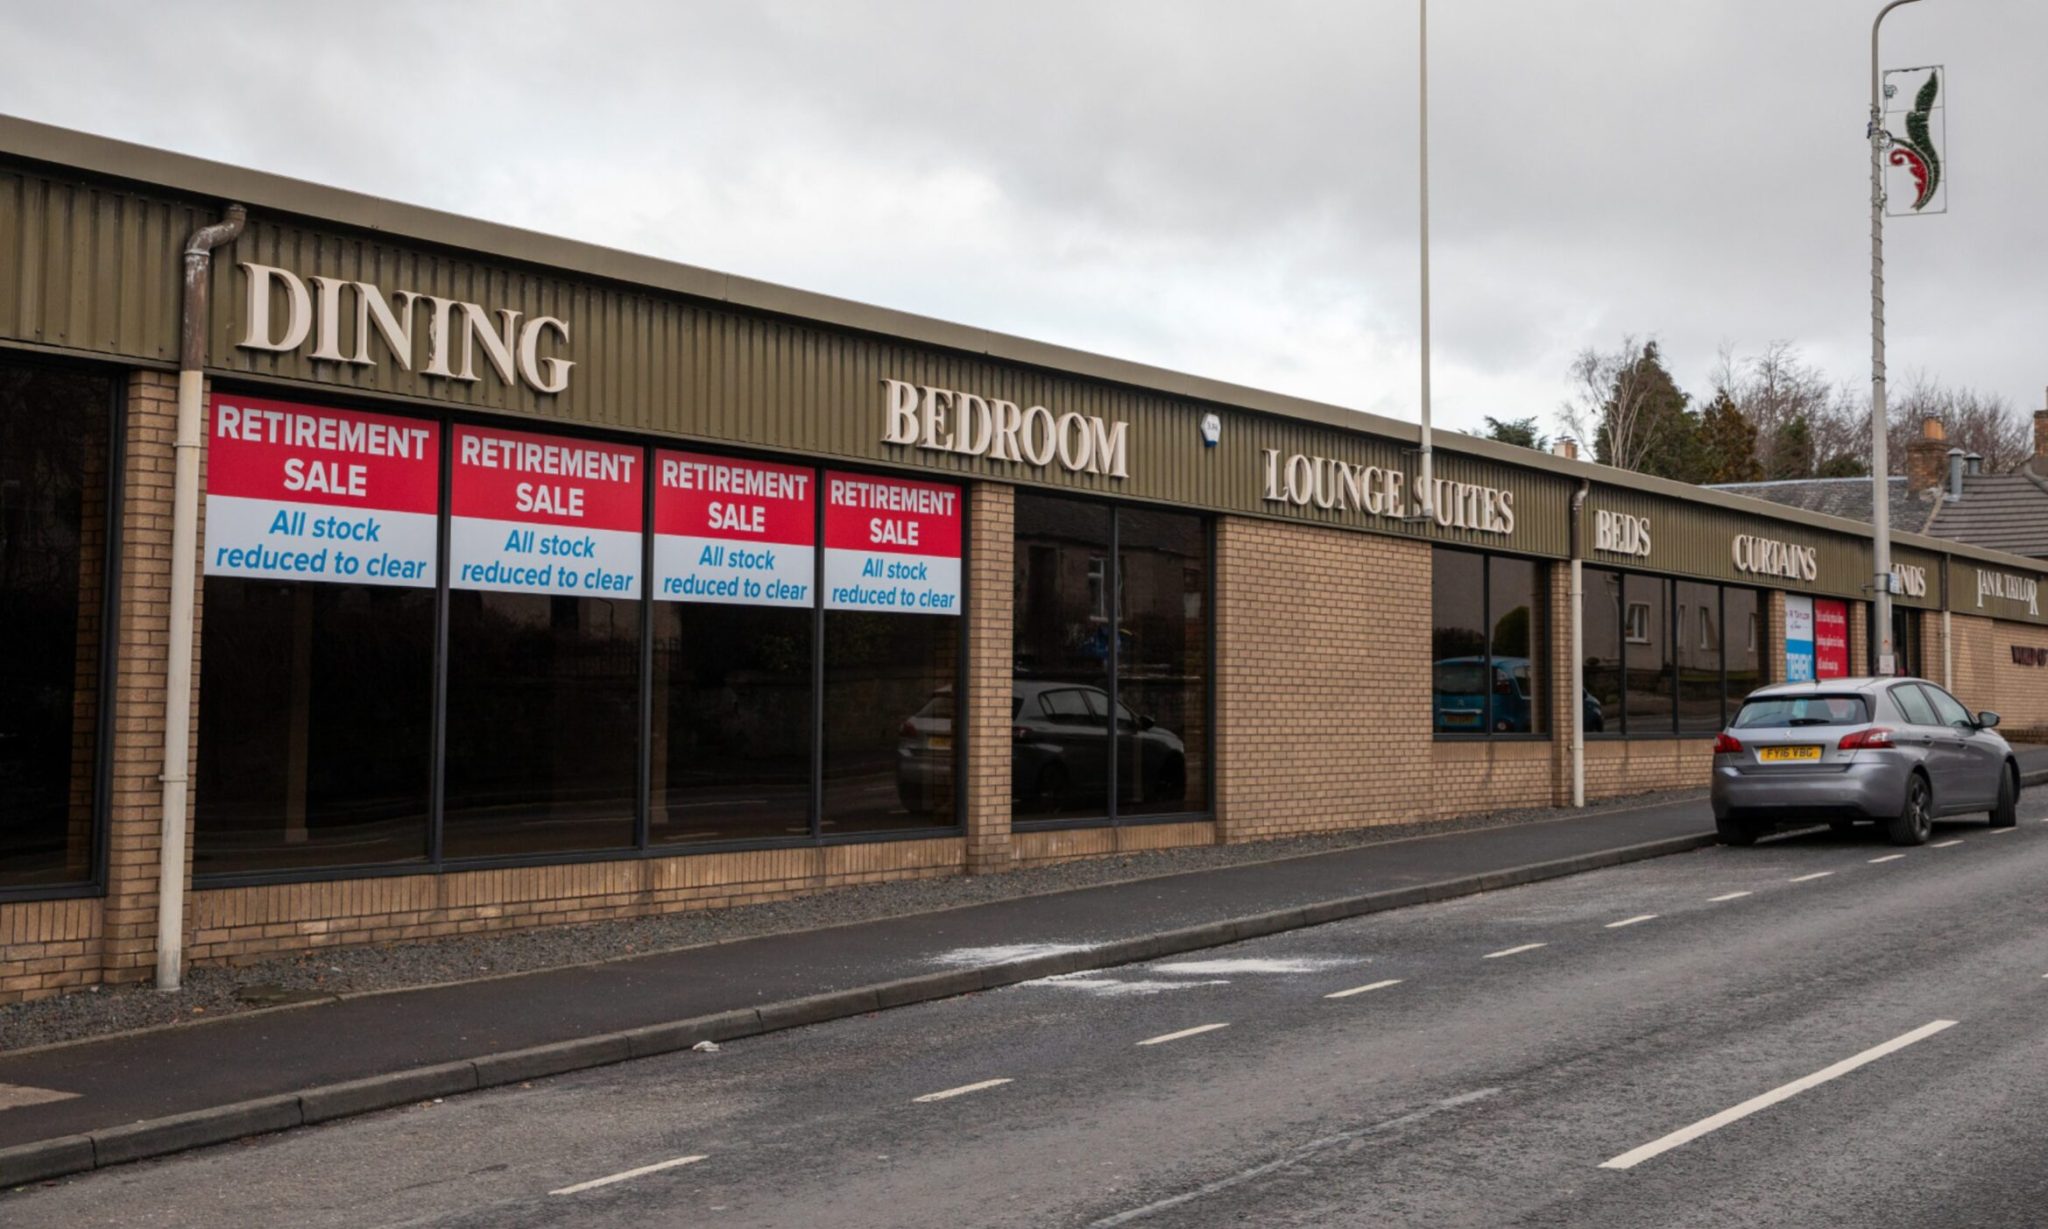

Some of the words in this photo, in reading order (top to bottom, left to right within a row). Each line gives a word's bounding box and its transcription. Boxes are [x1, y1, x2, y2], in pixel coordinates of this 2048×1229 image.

[236, 261, 576, 395] DINING
[217, 405, 430, 460] RETIREMENT
[881, 378, 1130, 479] BEDROOM
[283, 458, 367, 497] SALE
[461, 436, 635, 483] RETIREMENT
[662, 459, 808, 501] RETIREMENT
[830, 479, 955, 516] RETIREMENT
[1262, 448, 1405, 518] LOUNGE
[516, 482, 584, 517] SALE
[708, 501, 765, 533] SALE
[269, 508, 305, 537] All
[312, 514, 381, 542] stock
[869, 518, 919, 546] SALE
[1595, 509, 1650, 557] BEDS
[216, 543, 326, 574] reduced
[334, 550, 359, 575] to
[365, 553, 426, 580] clear
[504, 529, 533, 553] All
[539, 535, 595, 559] stock
[699, 545, 723, 567] All
[728, 548, 775, 570] stock
[1733, 534, 1818, 581] CURTAINS
[461, 560, 551, 587] reduced
[557, 566, 578, 587] to
[583, 568, 633, 592] clear
[664, 574, 739, 597] reduced
[743, 578, 761, 598] to
[765, 579, 807, 600] clear
[862, 558, 883, 578] All
[887, 560, 928, 581] stock
[832, 585, 897, 605] reduced
[900, 587, 915, 606] to
[919, 589, 955, 608] clear
